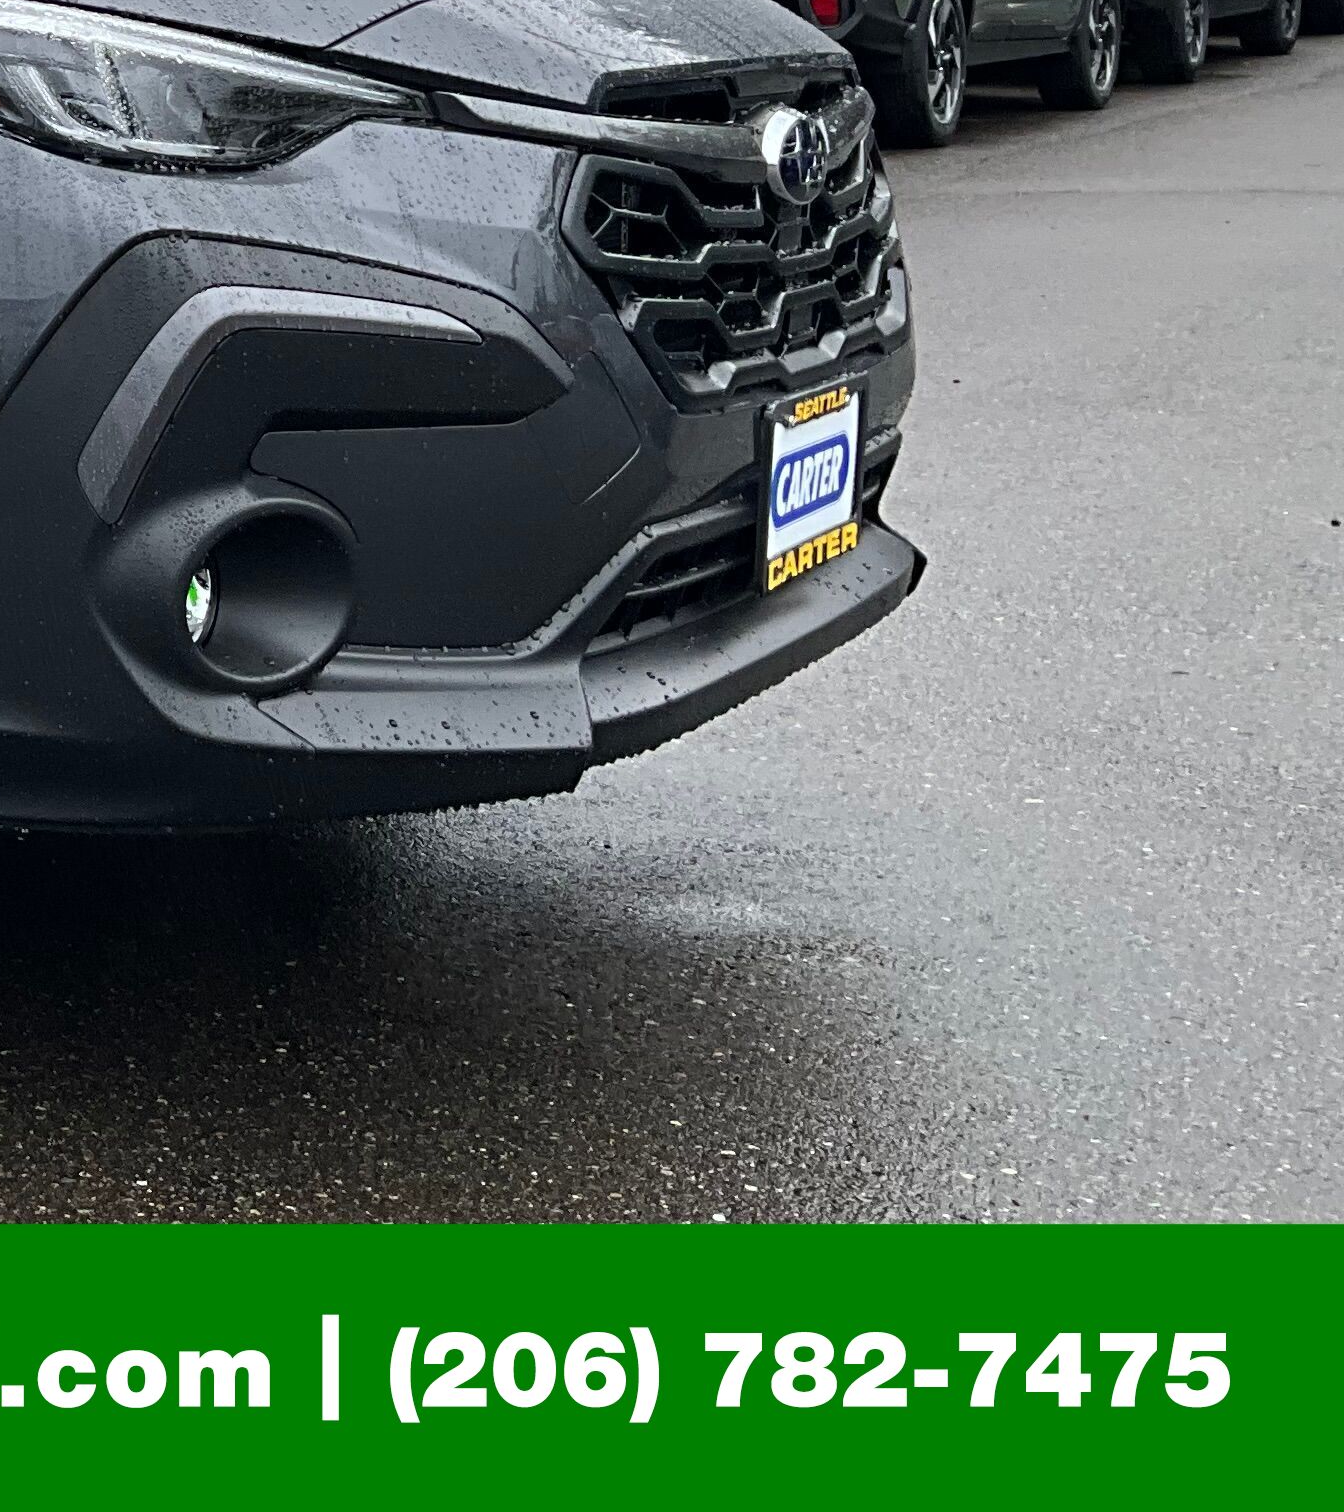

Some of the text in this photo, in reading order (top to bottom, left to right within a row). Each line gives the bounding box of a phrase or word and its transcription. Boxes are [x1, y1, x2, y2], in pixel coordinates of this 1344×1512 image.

[794, 386, 848, 422] SEATTLE
[776, 443, 844, 517] CARTER
[768, 521, 859, 591] CARTER
